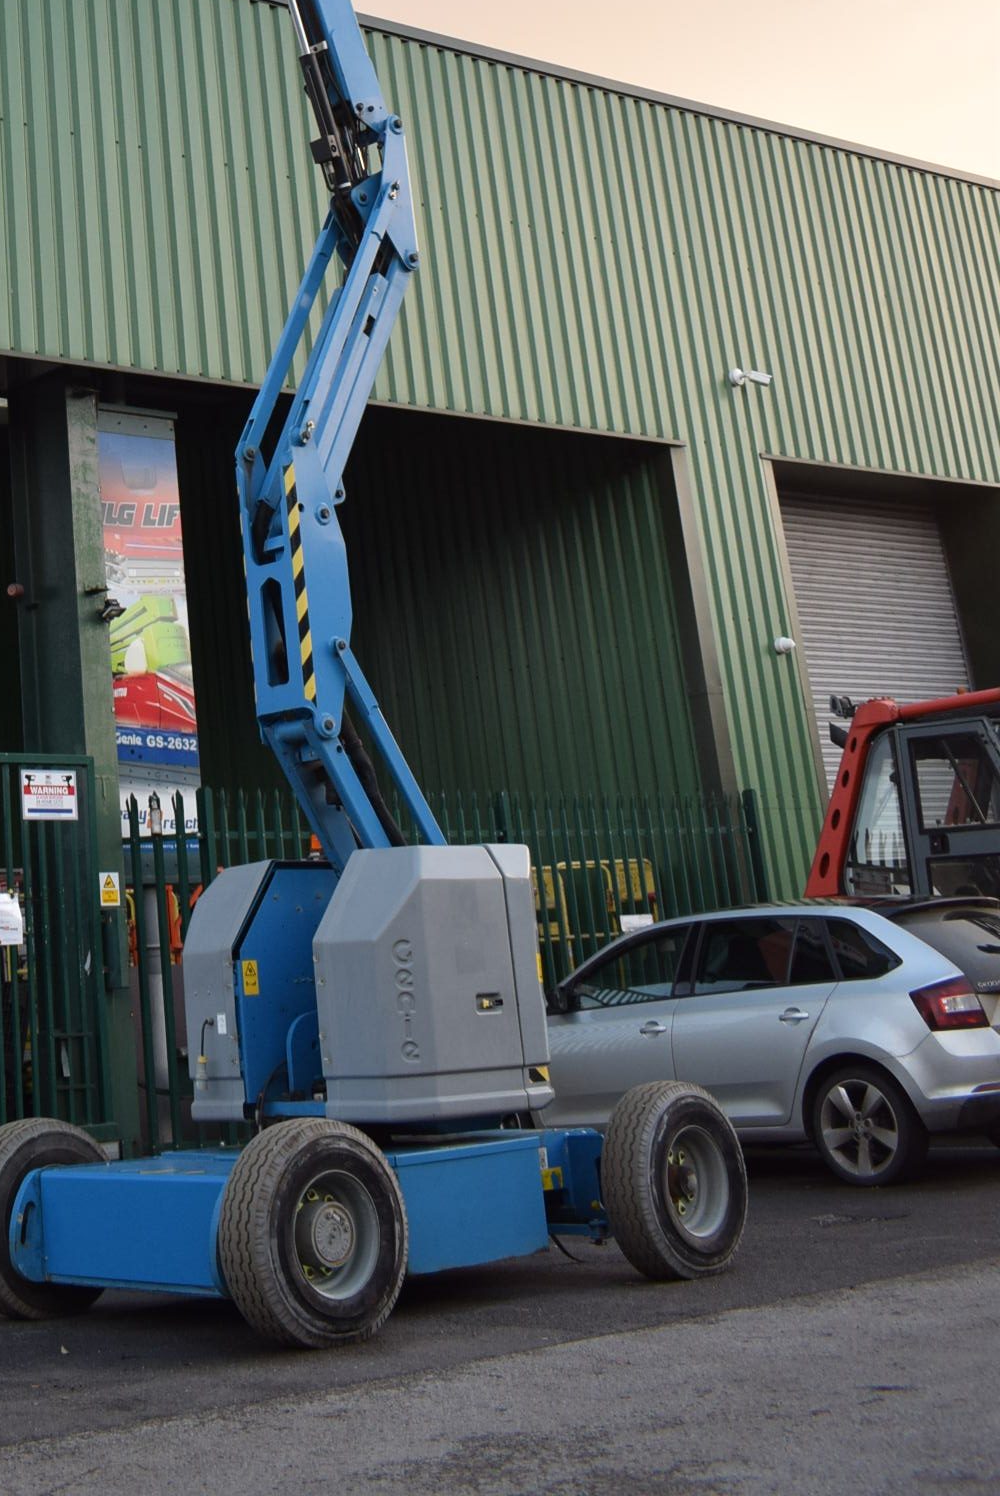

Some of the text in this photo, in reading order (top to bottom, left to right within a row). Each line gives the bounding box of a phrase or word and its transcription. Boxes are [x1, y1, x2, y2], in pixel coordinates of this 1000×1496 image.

[101, 500, 137, 527] LG
[146, 735, 197, 751] GS-2632
[30, 786, 69, 795] WARNING
[391, 938, 421, 1063] Genie
